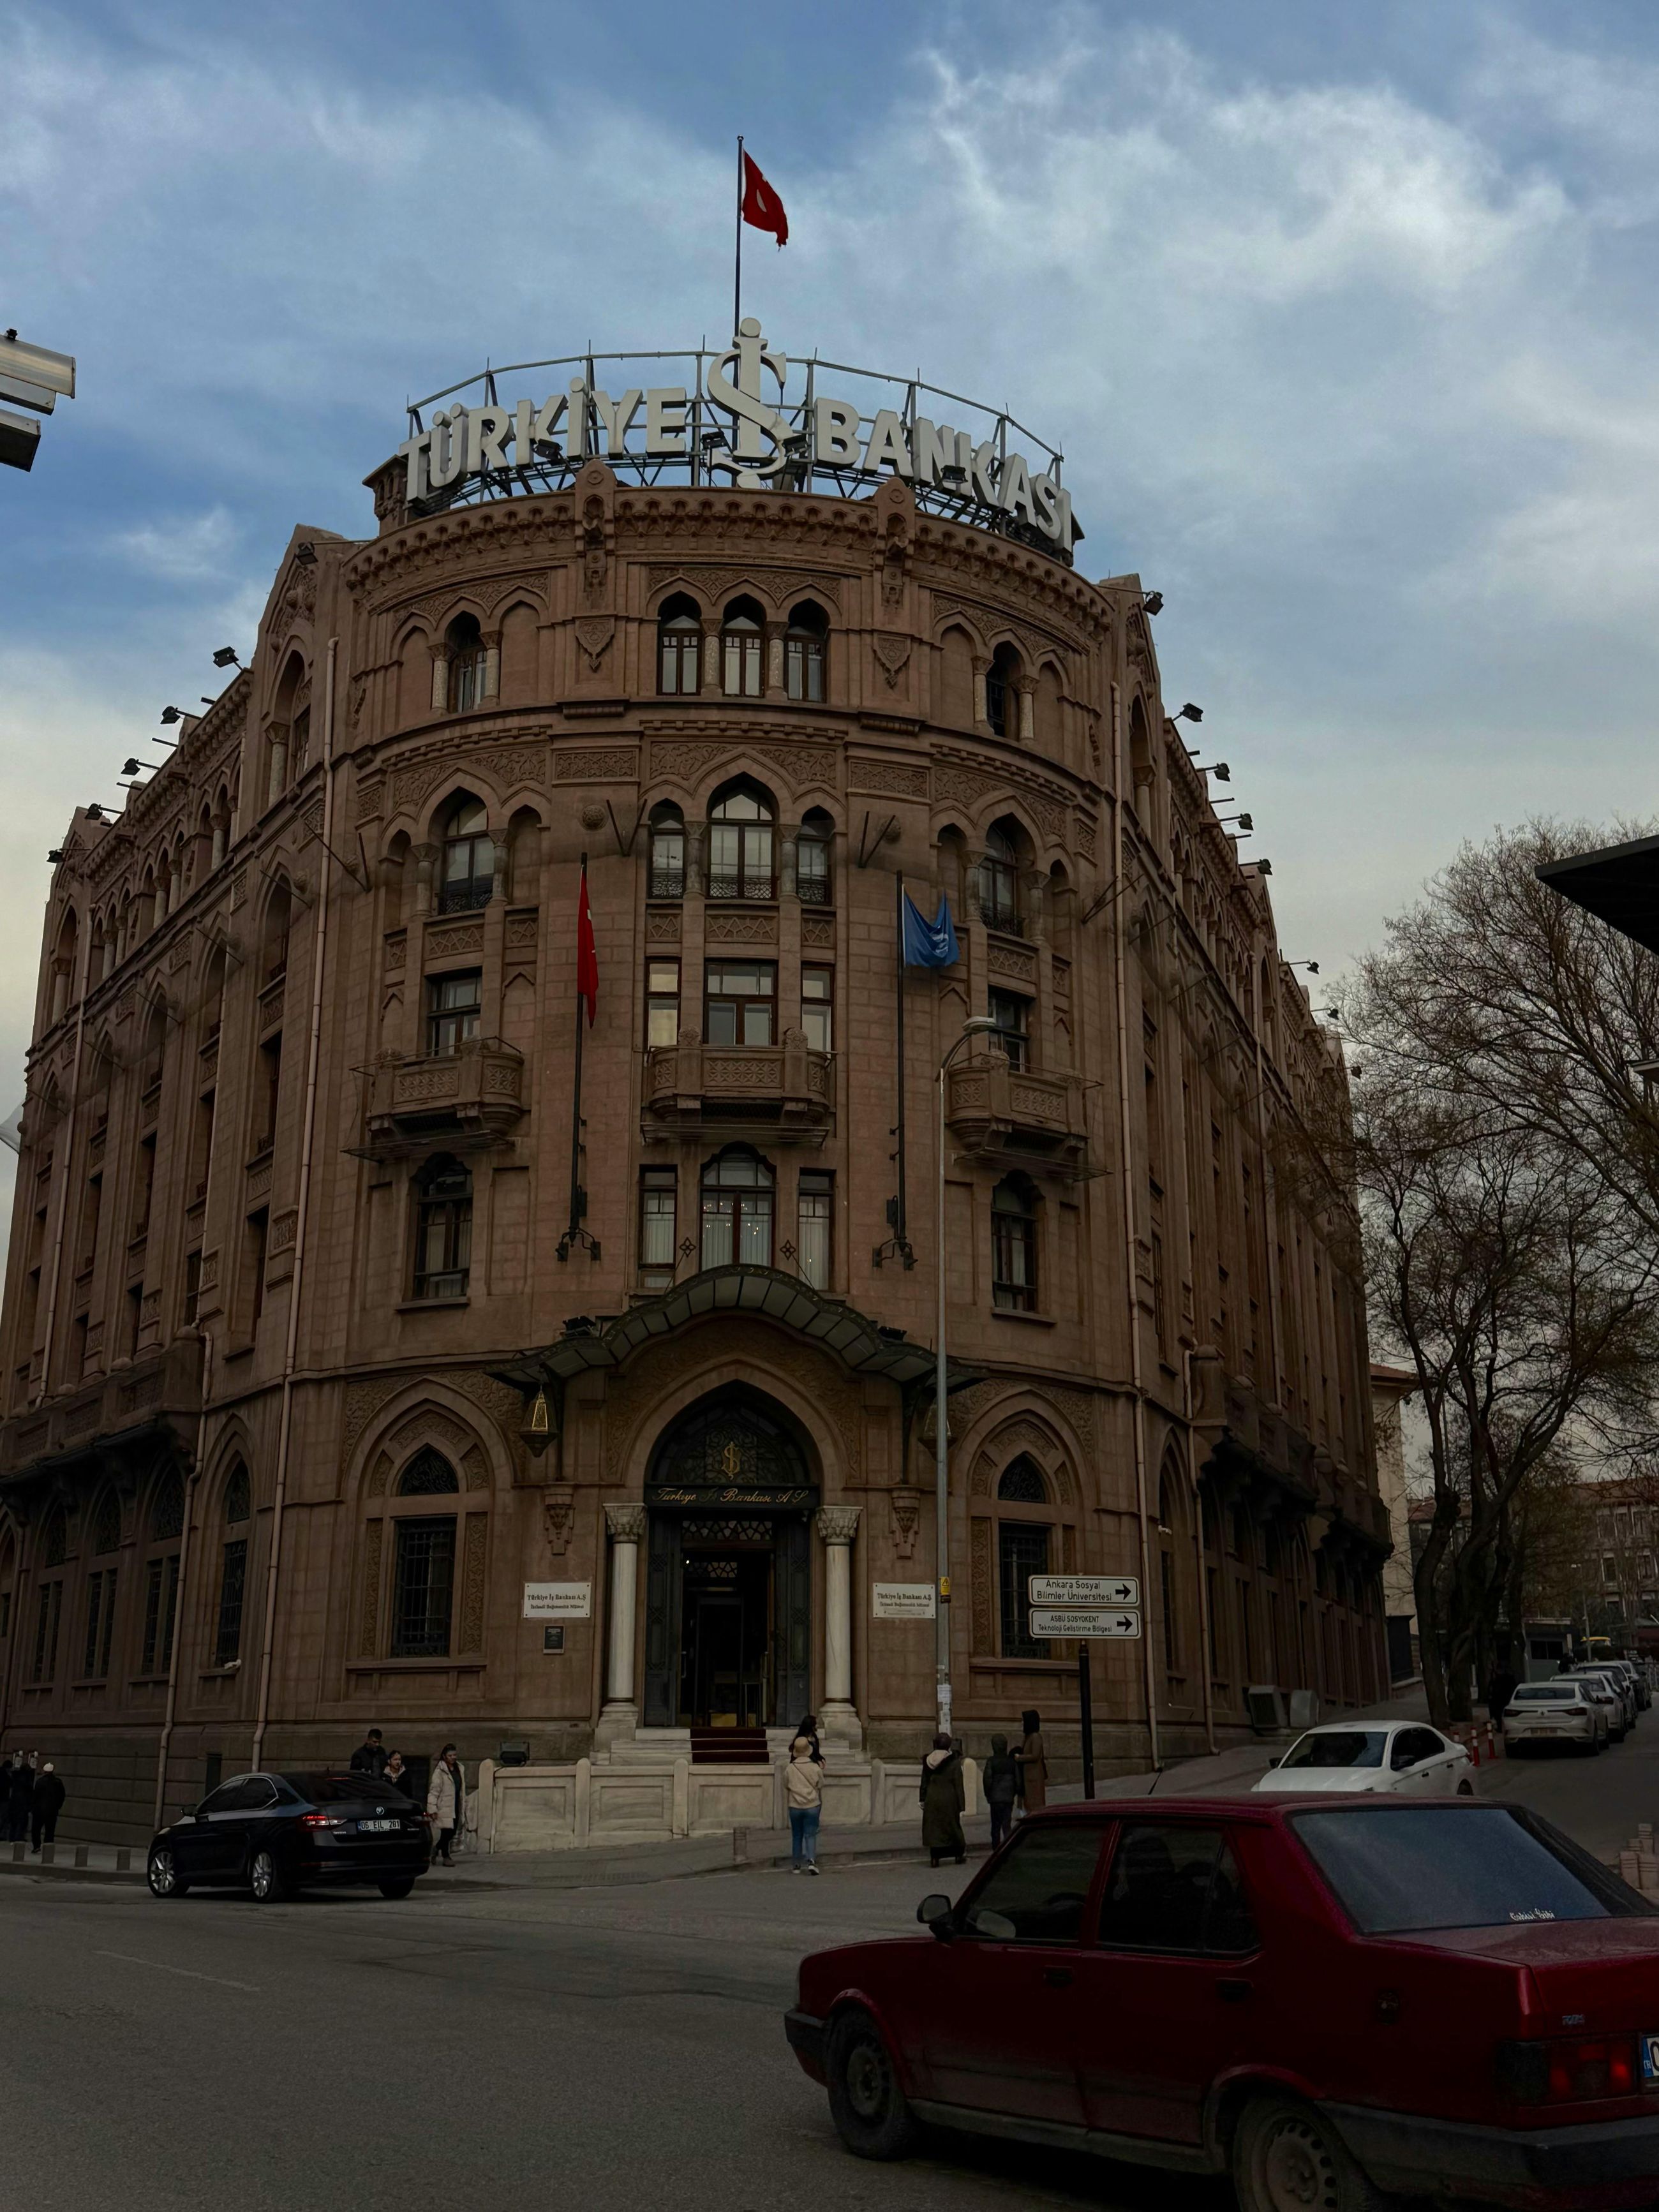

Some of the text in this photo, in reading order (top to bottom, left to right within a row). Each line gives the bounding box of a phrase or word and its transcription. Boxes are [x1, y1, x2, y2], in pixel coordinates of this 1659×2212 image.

[399, 376, 687, 505] TÜRKİYE
[814, 397, 1074, 554] BANKASI
[1046, 1580, 1100, 1591] Ankara Sosyal
[1037, 1589, 1112, 1601] Bilimler Üniversitesi
[1050, 1613, 1066, 1622] ASBÜ
[1038, 1624, 1062, 1633] Teknoloji
[1092, 1625, 1112, 1634] Bölgesi
[361, 1821, 369, 1829] 06
